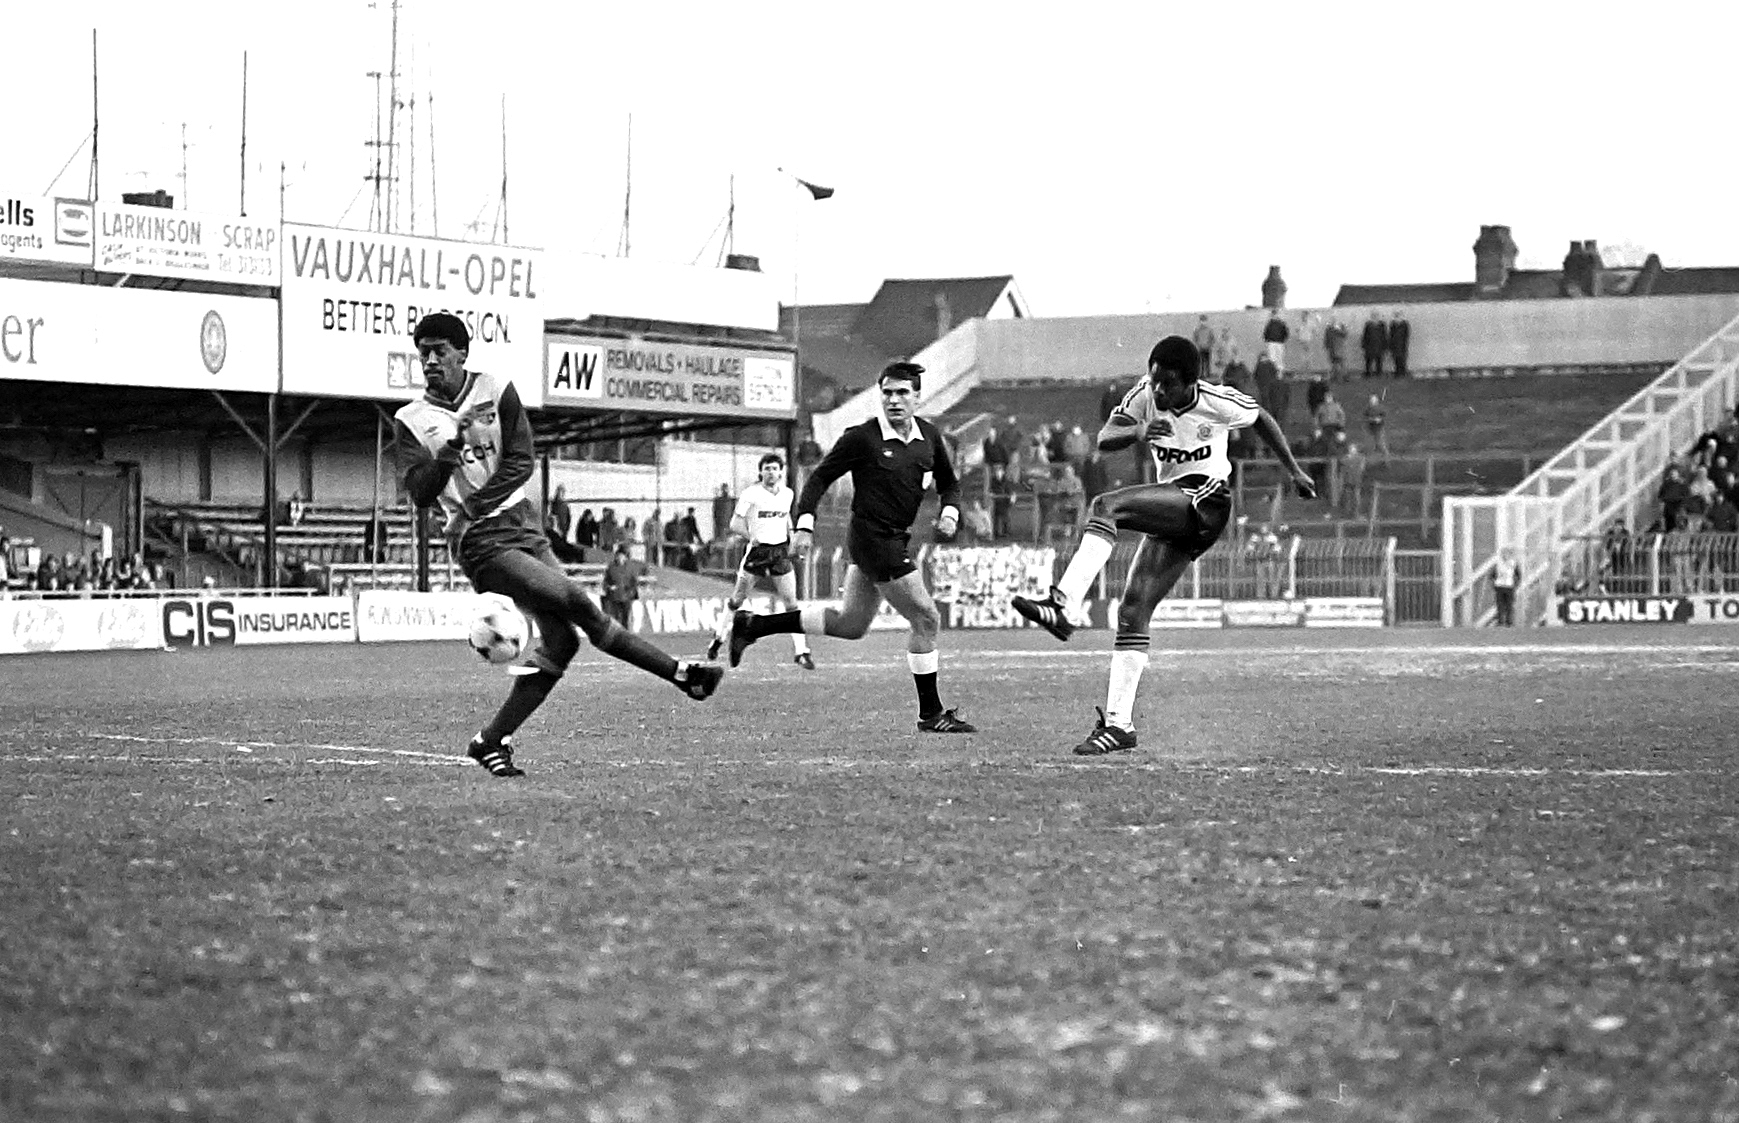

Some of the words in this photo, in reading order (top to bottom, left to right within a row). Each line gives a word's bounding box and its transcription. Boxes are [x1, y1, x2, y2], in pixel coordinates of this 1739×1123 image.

[0, 233, 43, 253] agents
[102, 211, 202, 246] LARKINSON
[222, 224, 276, 252] SCRAP
[292, 235, 537, 298] VAUXHALL-OPEL
[1, 314, 45, 364] er
[554, 351, 597, 390] AW
[162, 600, 236, 647] CIS
[238, 612, 351, 632] INSURANCE
[1568, 600, 1679, 622] STANLEY
